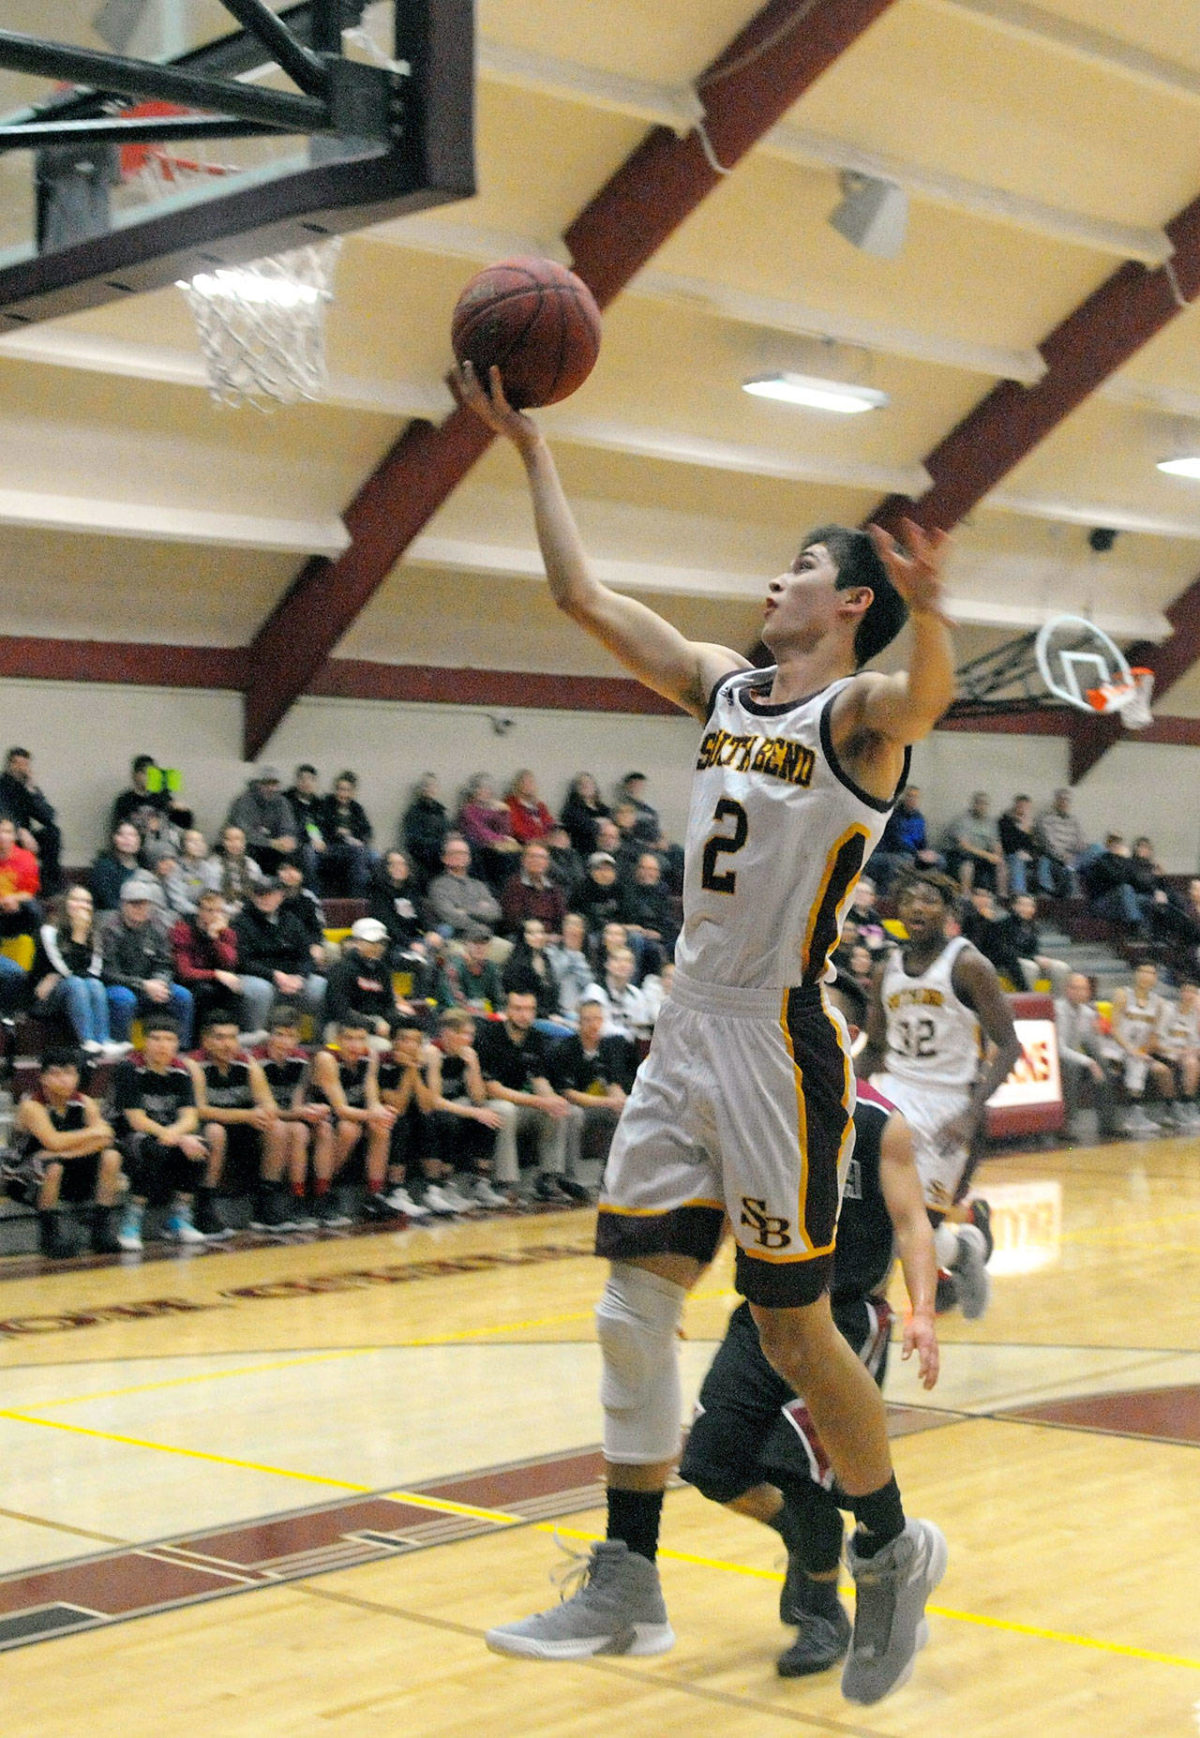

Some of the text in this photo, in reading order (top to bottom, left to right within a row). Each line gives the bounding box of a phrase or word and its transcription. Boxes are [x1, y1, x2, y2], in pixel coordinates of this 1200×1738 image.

[750, 734, 817, 789] BEND
[701, 797, 748, 895] 2
[740, 1197, 791, 1249] SB
